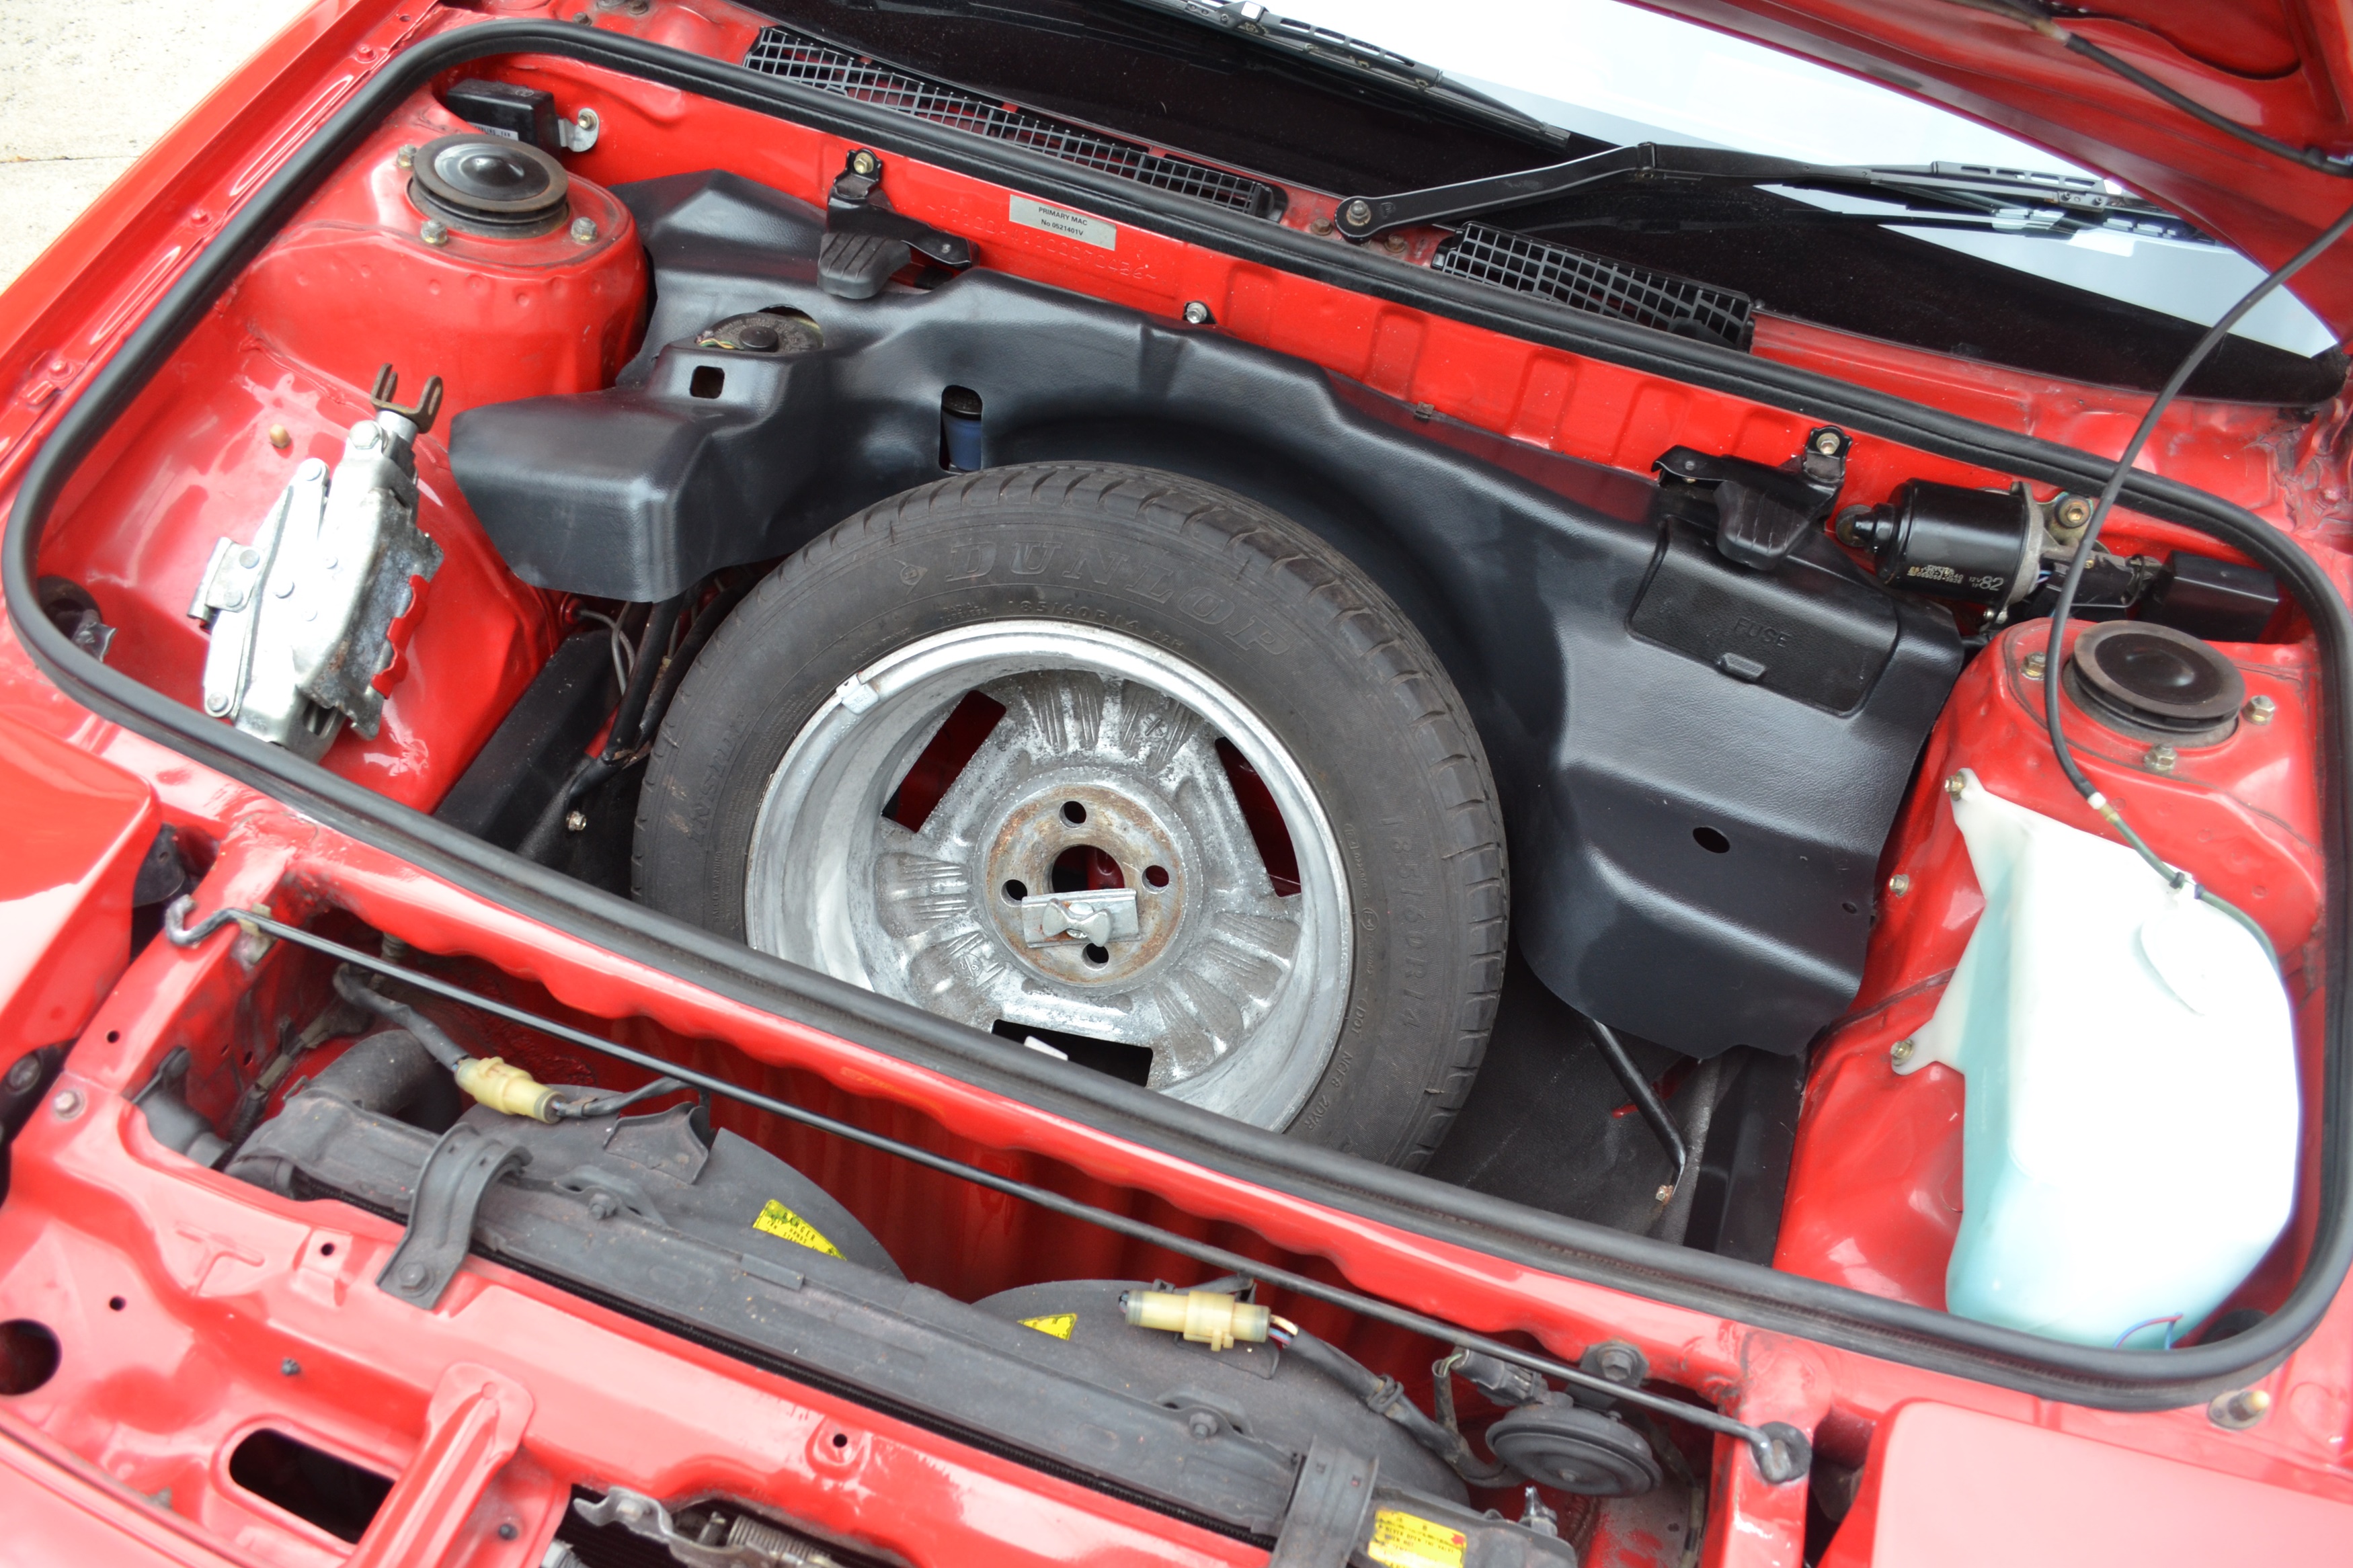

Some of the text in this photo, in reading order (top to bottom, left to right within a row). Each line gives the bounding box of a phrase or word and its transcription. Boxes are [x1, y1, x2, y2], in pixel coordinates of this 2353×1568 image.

[1038, 206, 1088, 226] PRIMARY MAC
[1041, 219, 1084, 236] No 0521401V
[945, 540, 1304, 656] DUNLOP
[1979, 575, 2004, 591] 82
[1007, 600, 1185, 651] 185/60R14 82H
[1733, 616, 1794, 649] FUSE
[1351, 1005, 1367, 1038] DOT
[782, 1212, 816, 1242] DANGER
[789, 1227, 807, 1244] HANDS
